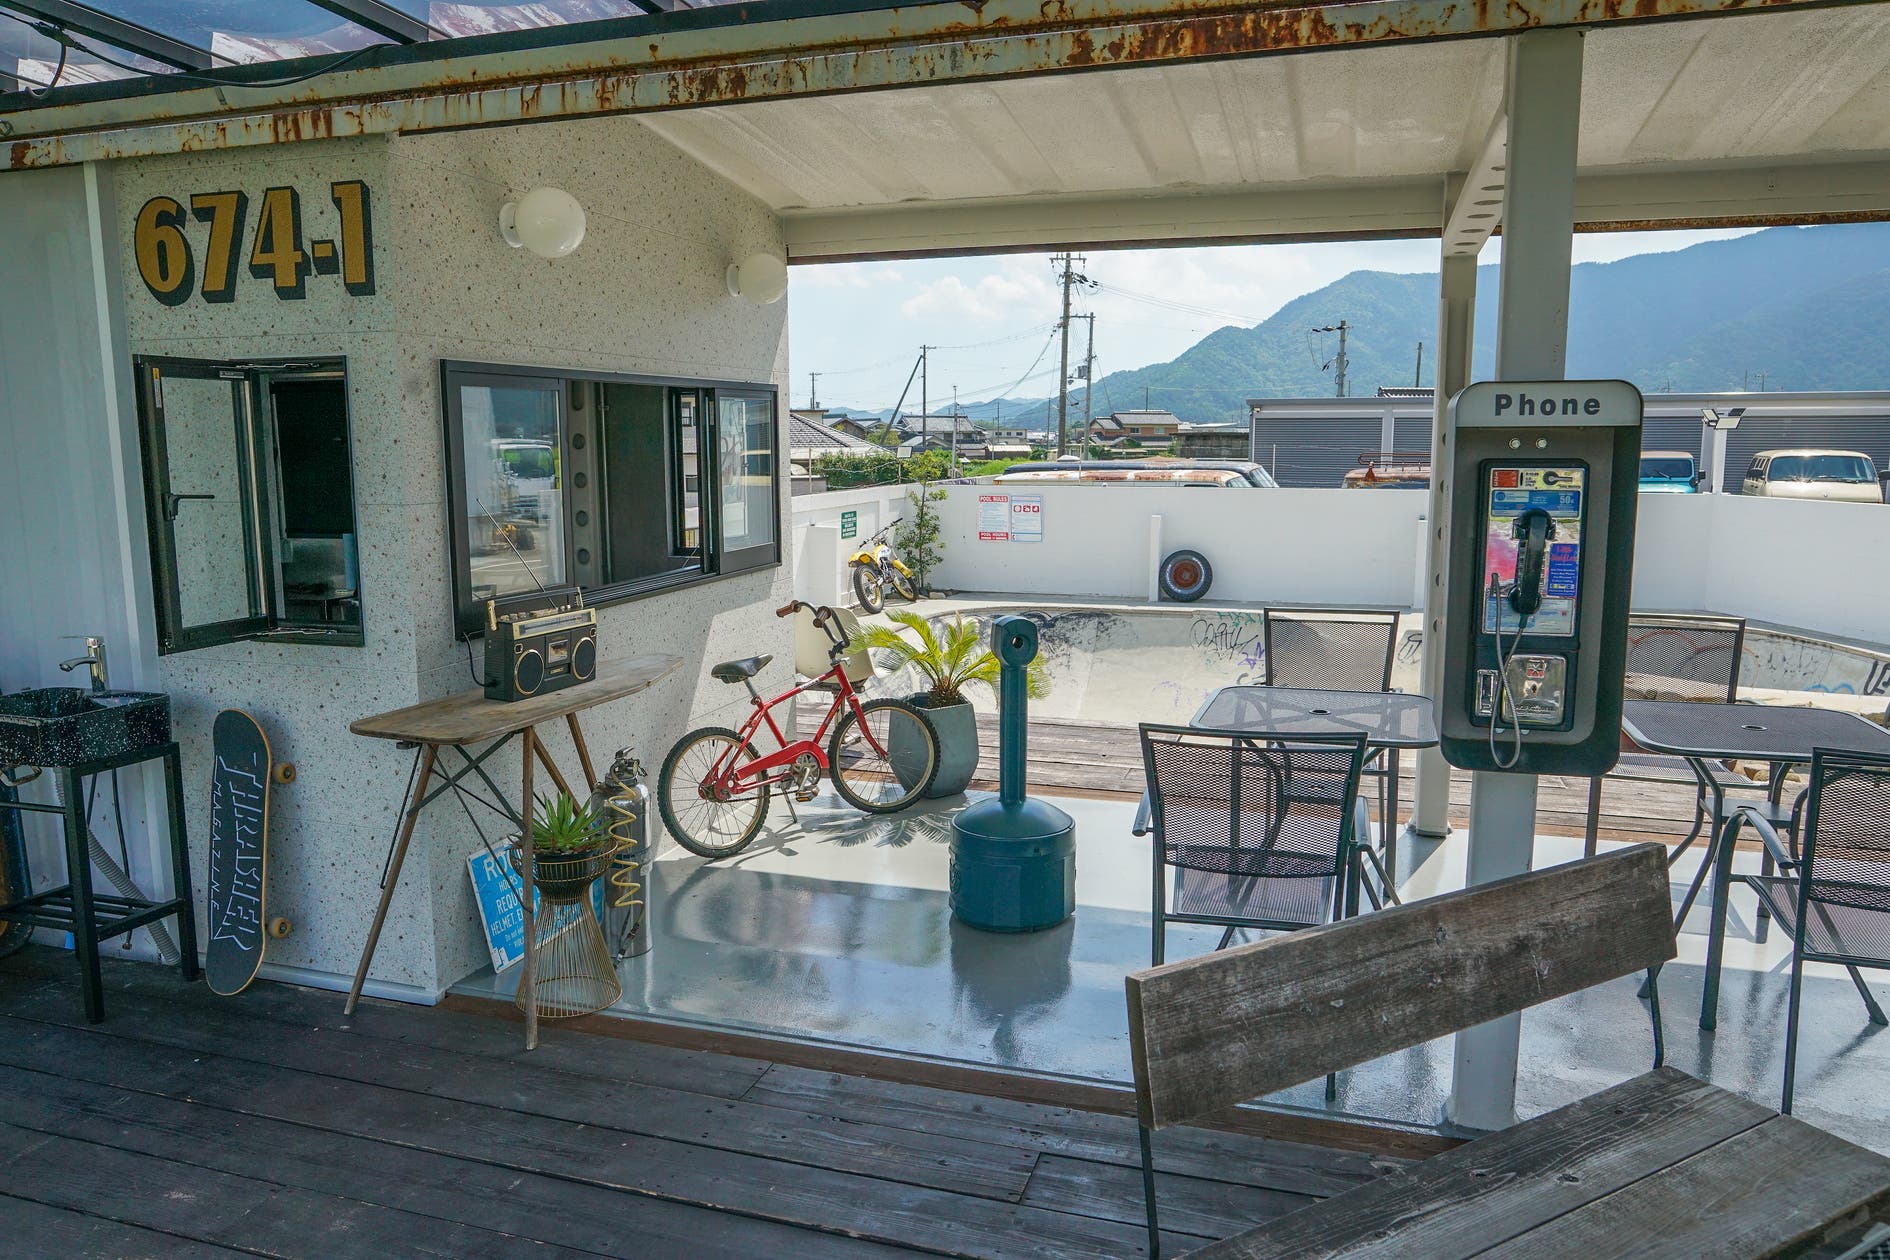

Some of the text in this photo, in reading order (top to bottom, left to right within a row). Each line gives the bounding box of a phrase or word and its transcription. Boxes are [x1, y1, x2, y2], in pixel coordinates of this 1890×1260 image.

[134, 179, 376, 306] 674-1
[1494, 393, 1601, 417] Phone
[211, 779, 222, 911] MAGAZINE
[214, 752, 263, 950] THRASHER
